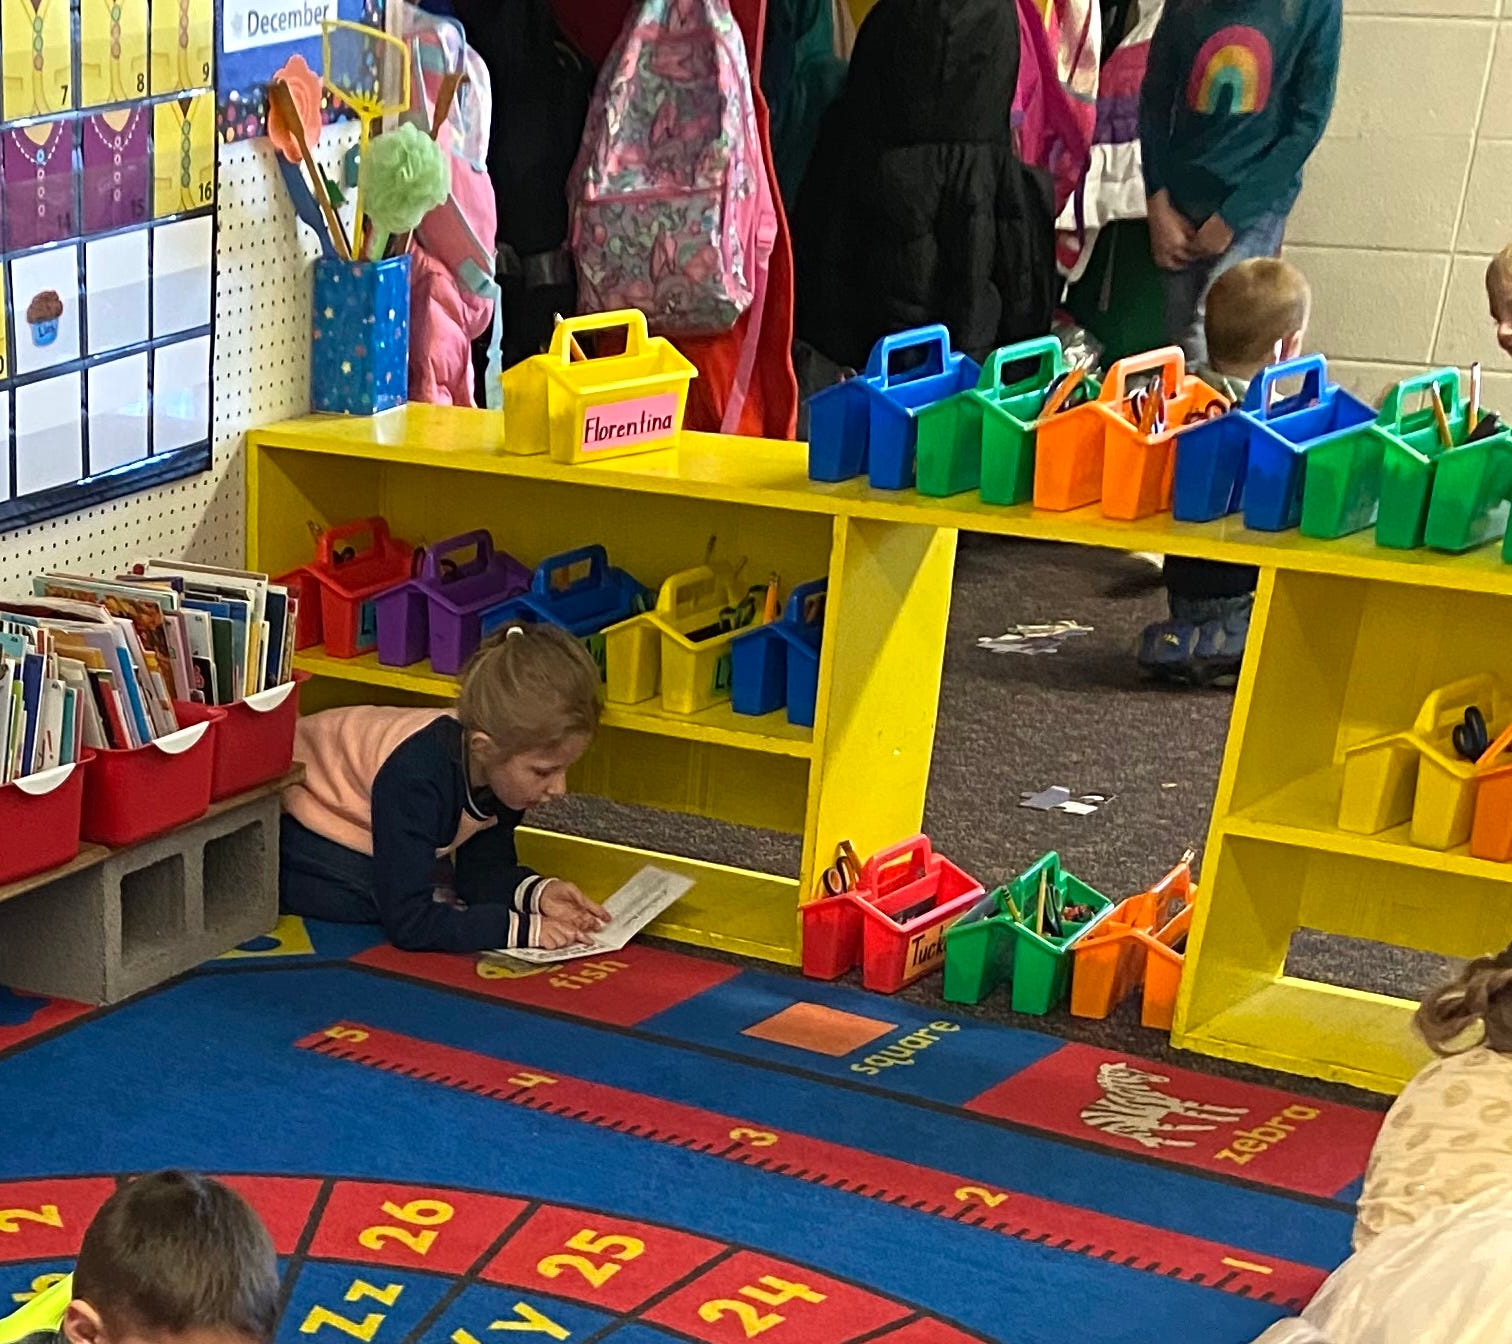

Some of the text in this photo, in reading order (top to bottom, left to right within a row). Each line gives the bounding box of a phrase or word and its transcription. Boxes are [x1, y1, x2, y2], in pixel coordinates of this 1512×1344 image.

[248, 5, 330, 37] December
[136, 73, 145, 92] 8
[202, 62, 210, 82] 9
[60, 85, 69, 105] 7
[198, 180, 212, 201] 16
[583, 410, 673, 444] Florentina
[548, 958, 631, 990] fish
[324, 1026, 370, 1044] 5
[849, 1018, 962, 1078] square
[507, 1070, 558, 1088] 4
[728, 1126, 779, 1148] 3
[1213, 1103, 1323, 1167] zebra
[952, 1184, 1009, 1209] 2
[357, 1199, 455, 1255] 26
[536, 1228, 646, 1288] 25
[299, 1279, 404, 1342] Zz
[697, 1274, 828, 1338] 24
